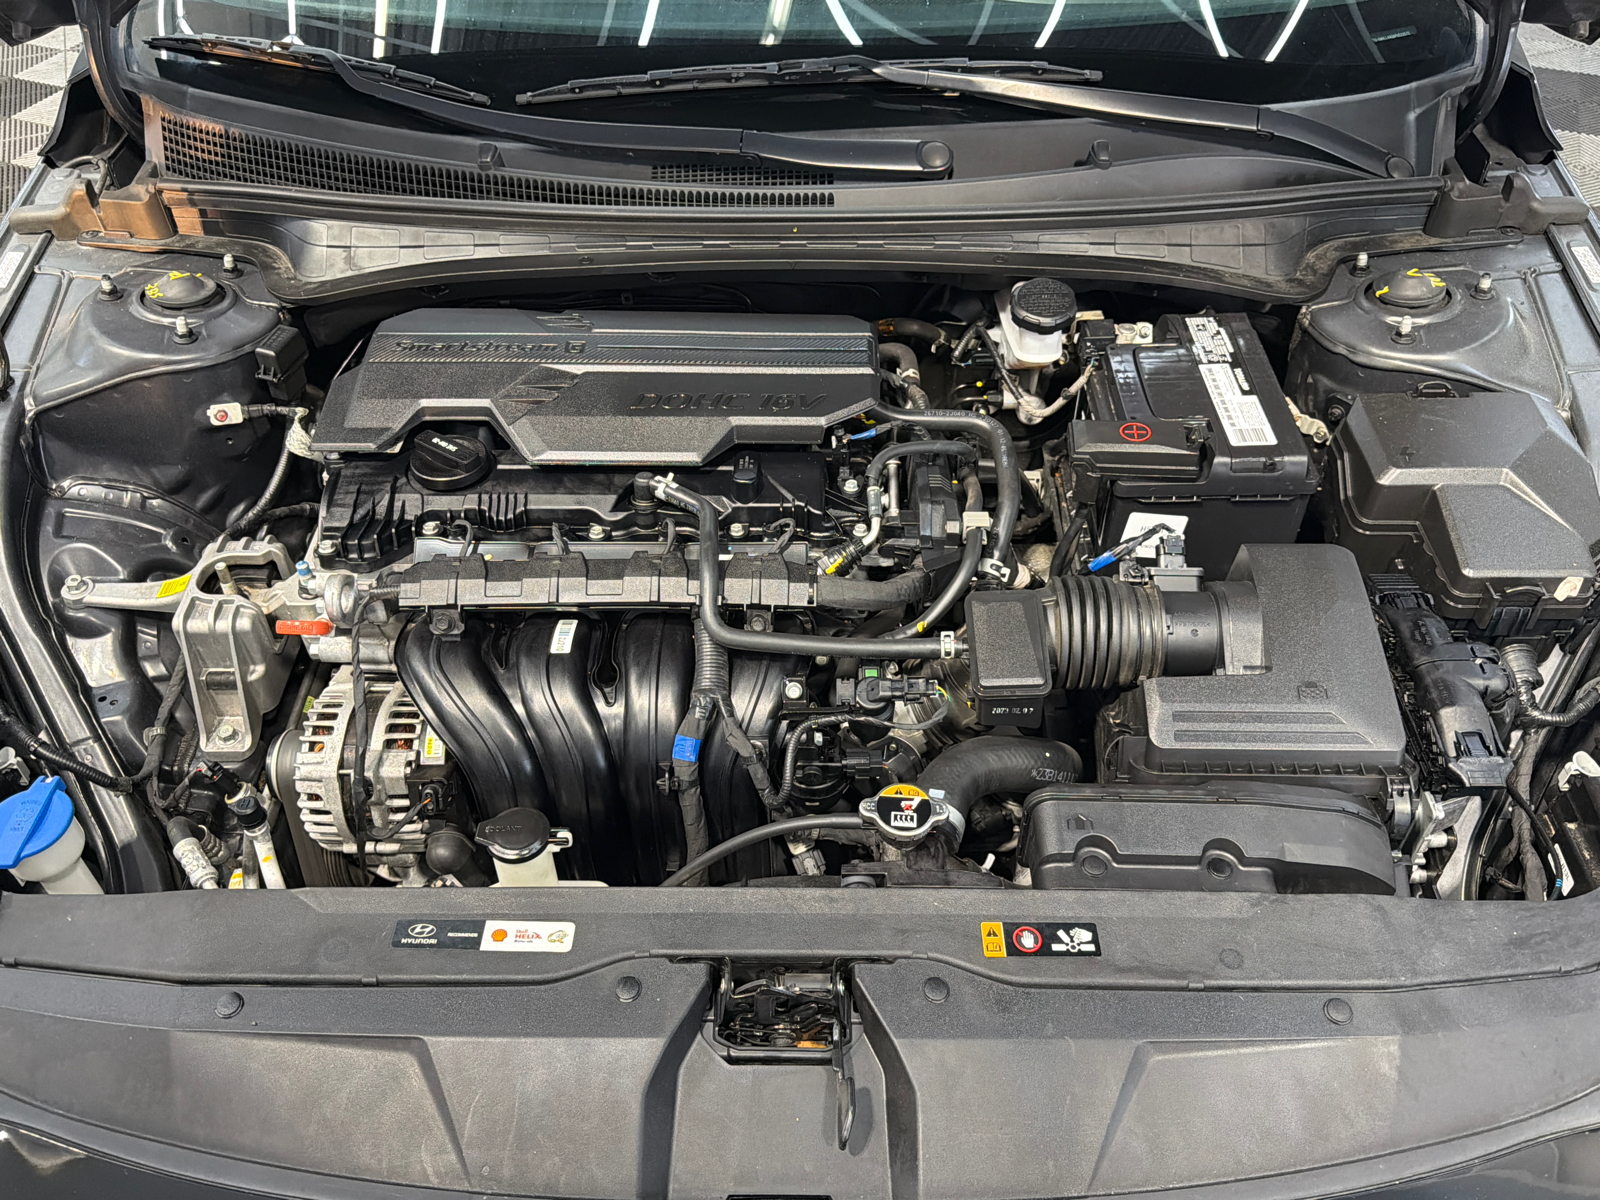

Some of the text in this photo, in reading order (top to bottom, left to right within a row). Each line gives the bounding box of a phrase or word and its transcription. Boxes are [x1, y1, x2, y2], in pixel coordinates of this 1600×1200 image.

[396, 340, 558, 353] Smartstream
[630, 393, 828, 410] DOHC 16V
[485, 825, 522, 833] COOLANT
[515, 932, 542, 940] HELIX
